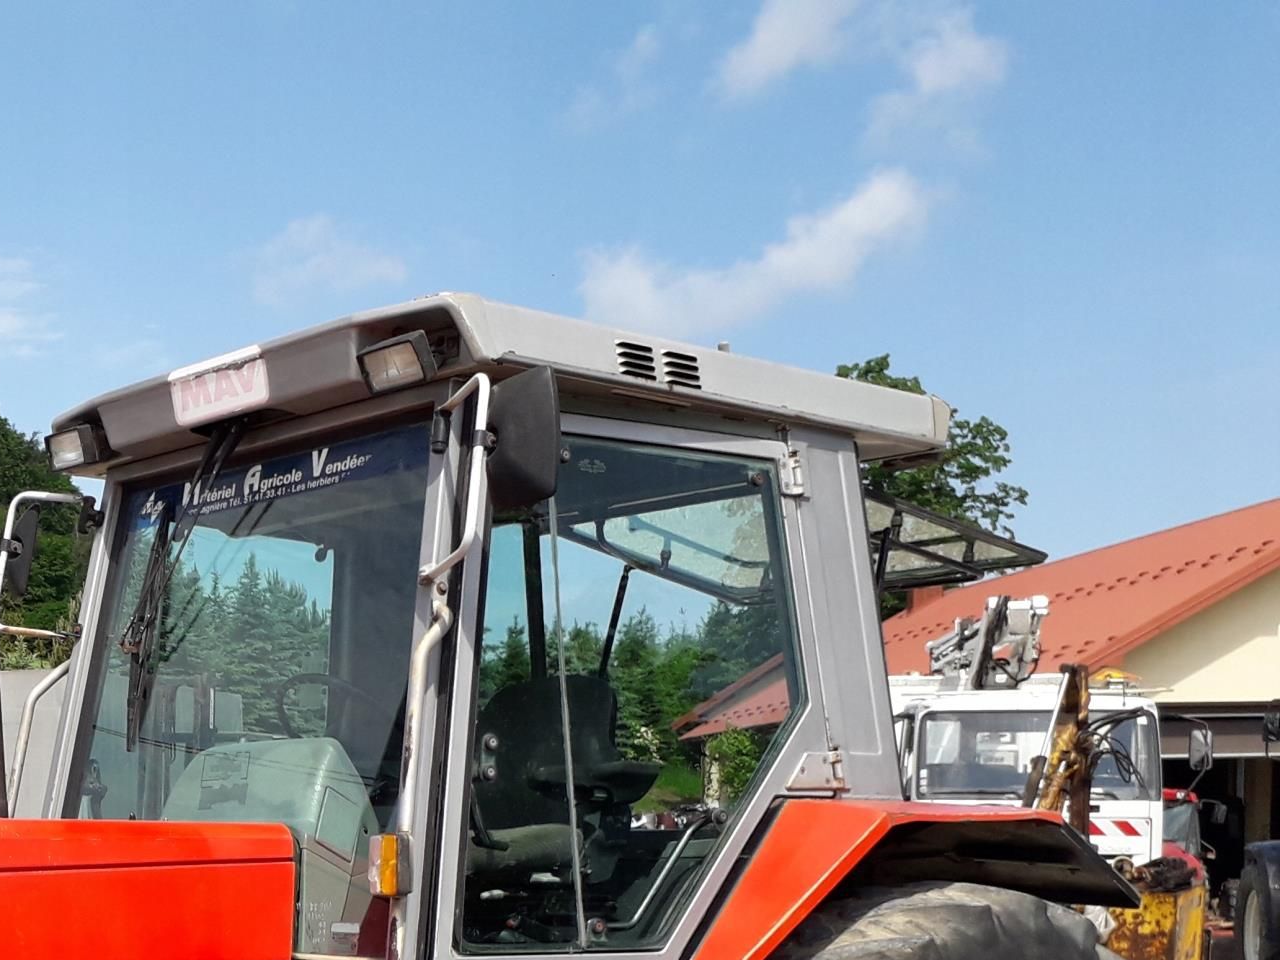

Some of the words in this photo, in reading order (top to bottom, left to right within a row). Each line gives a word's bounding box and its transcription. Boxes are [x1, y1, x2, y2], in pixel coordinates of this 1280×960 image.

[181, 360, 257, 412] MAV
[243, 464, 303, 499] Agricole
[291, 483, 306, 493] Les
